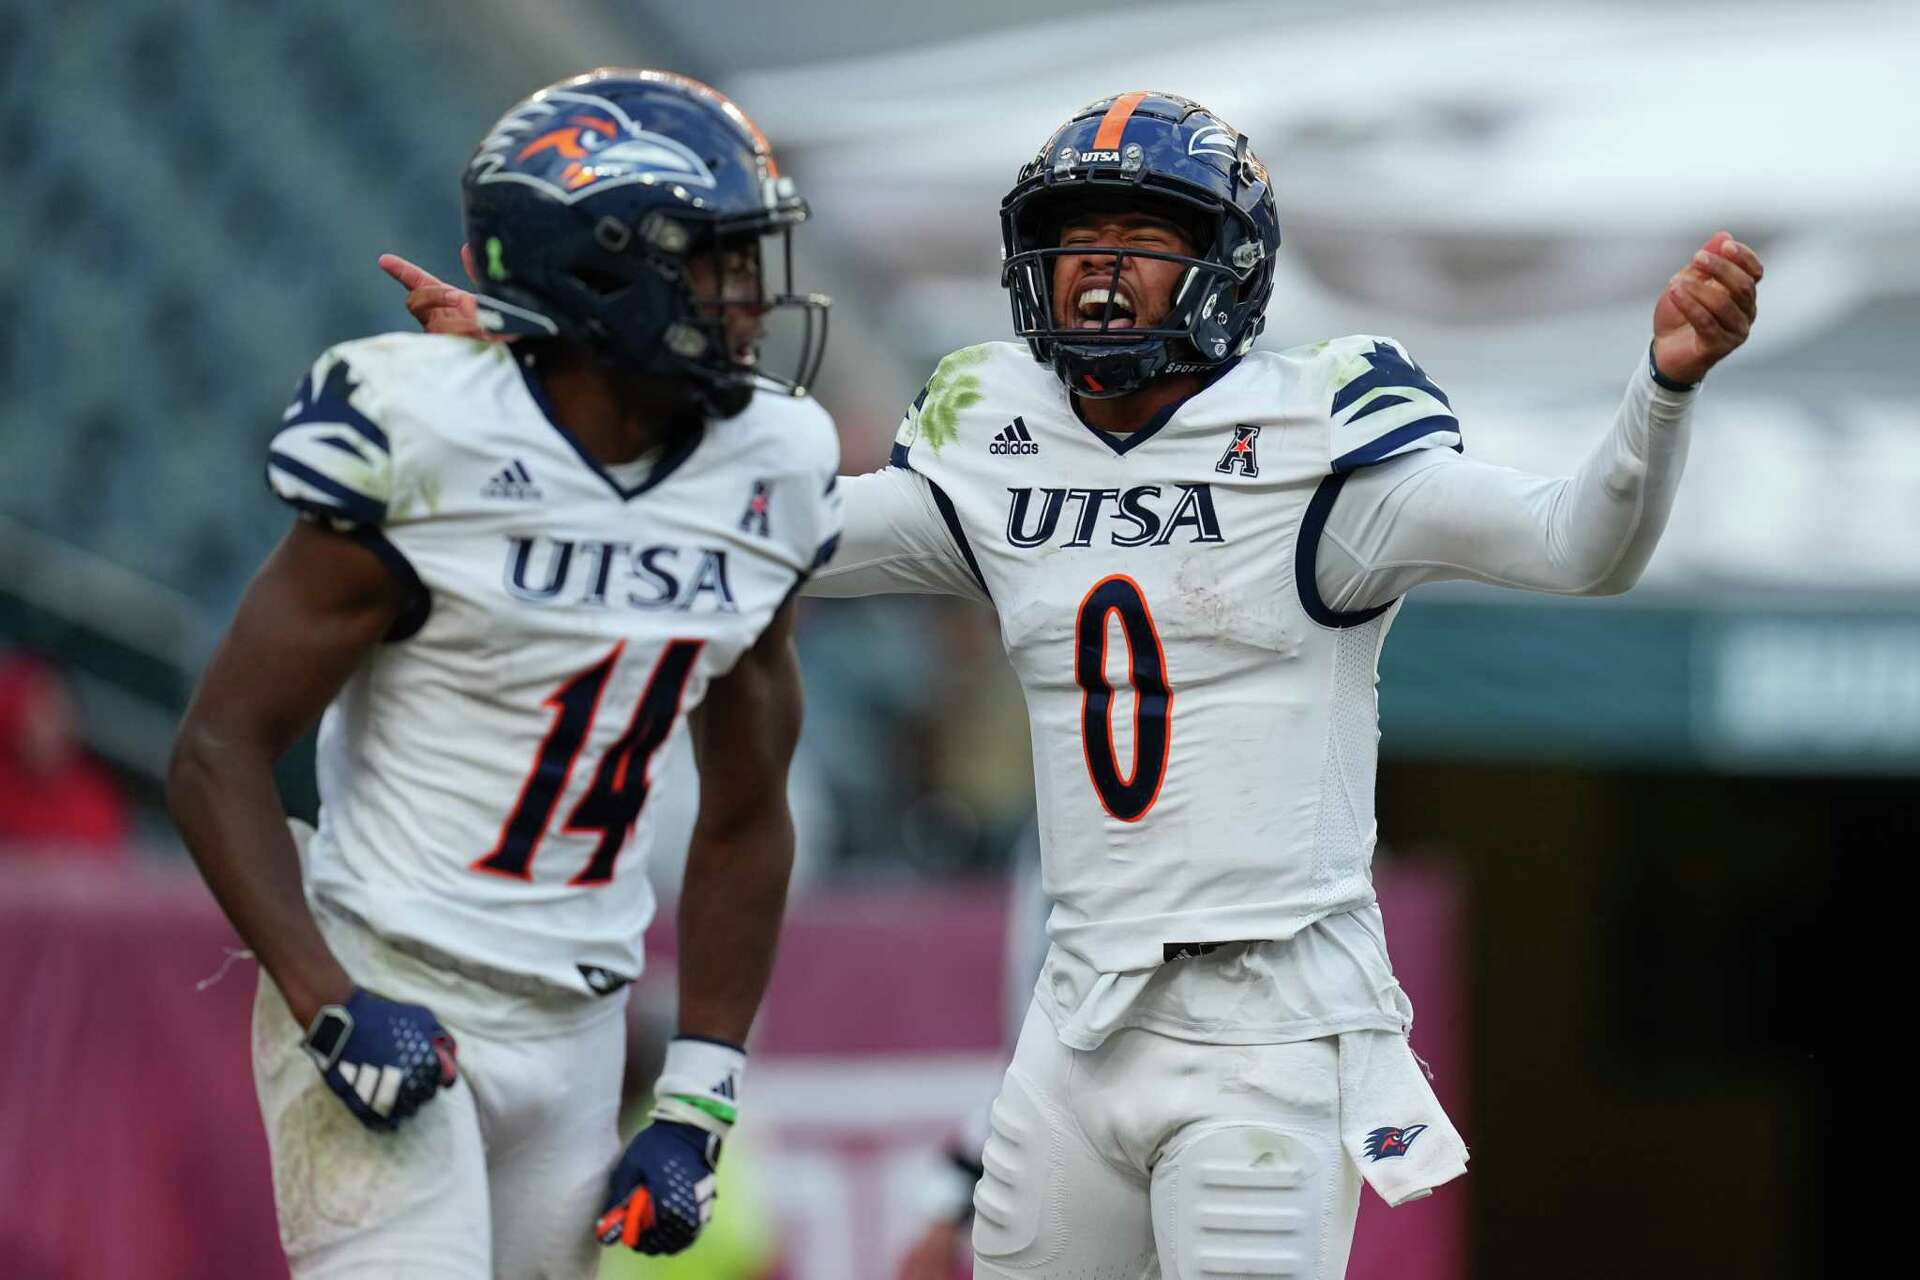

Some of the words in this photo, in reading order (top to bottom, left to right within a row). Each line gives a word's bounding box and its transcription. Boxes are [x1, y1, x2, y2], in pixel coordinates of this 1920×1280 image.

[1081, 151, 1120, 162] UTSA
[989, 440, 1039, 455] adidas
[1215, 424, 1260, 478] A
[1007, 483, 1225, 549] UTSA
[503, 536, 739, 614] UTSA
[1075, 573, 1174, 823] 0
[468, 638, 708, 887] 14
